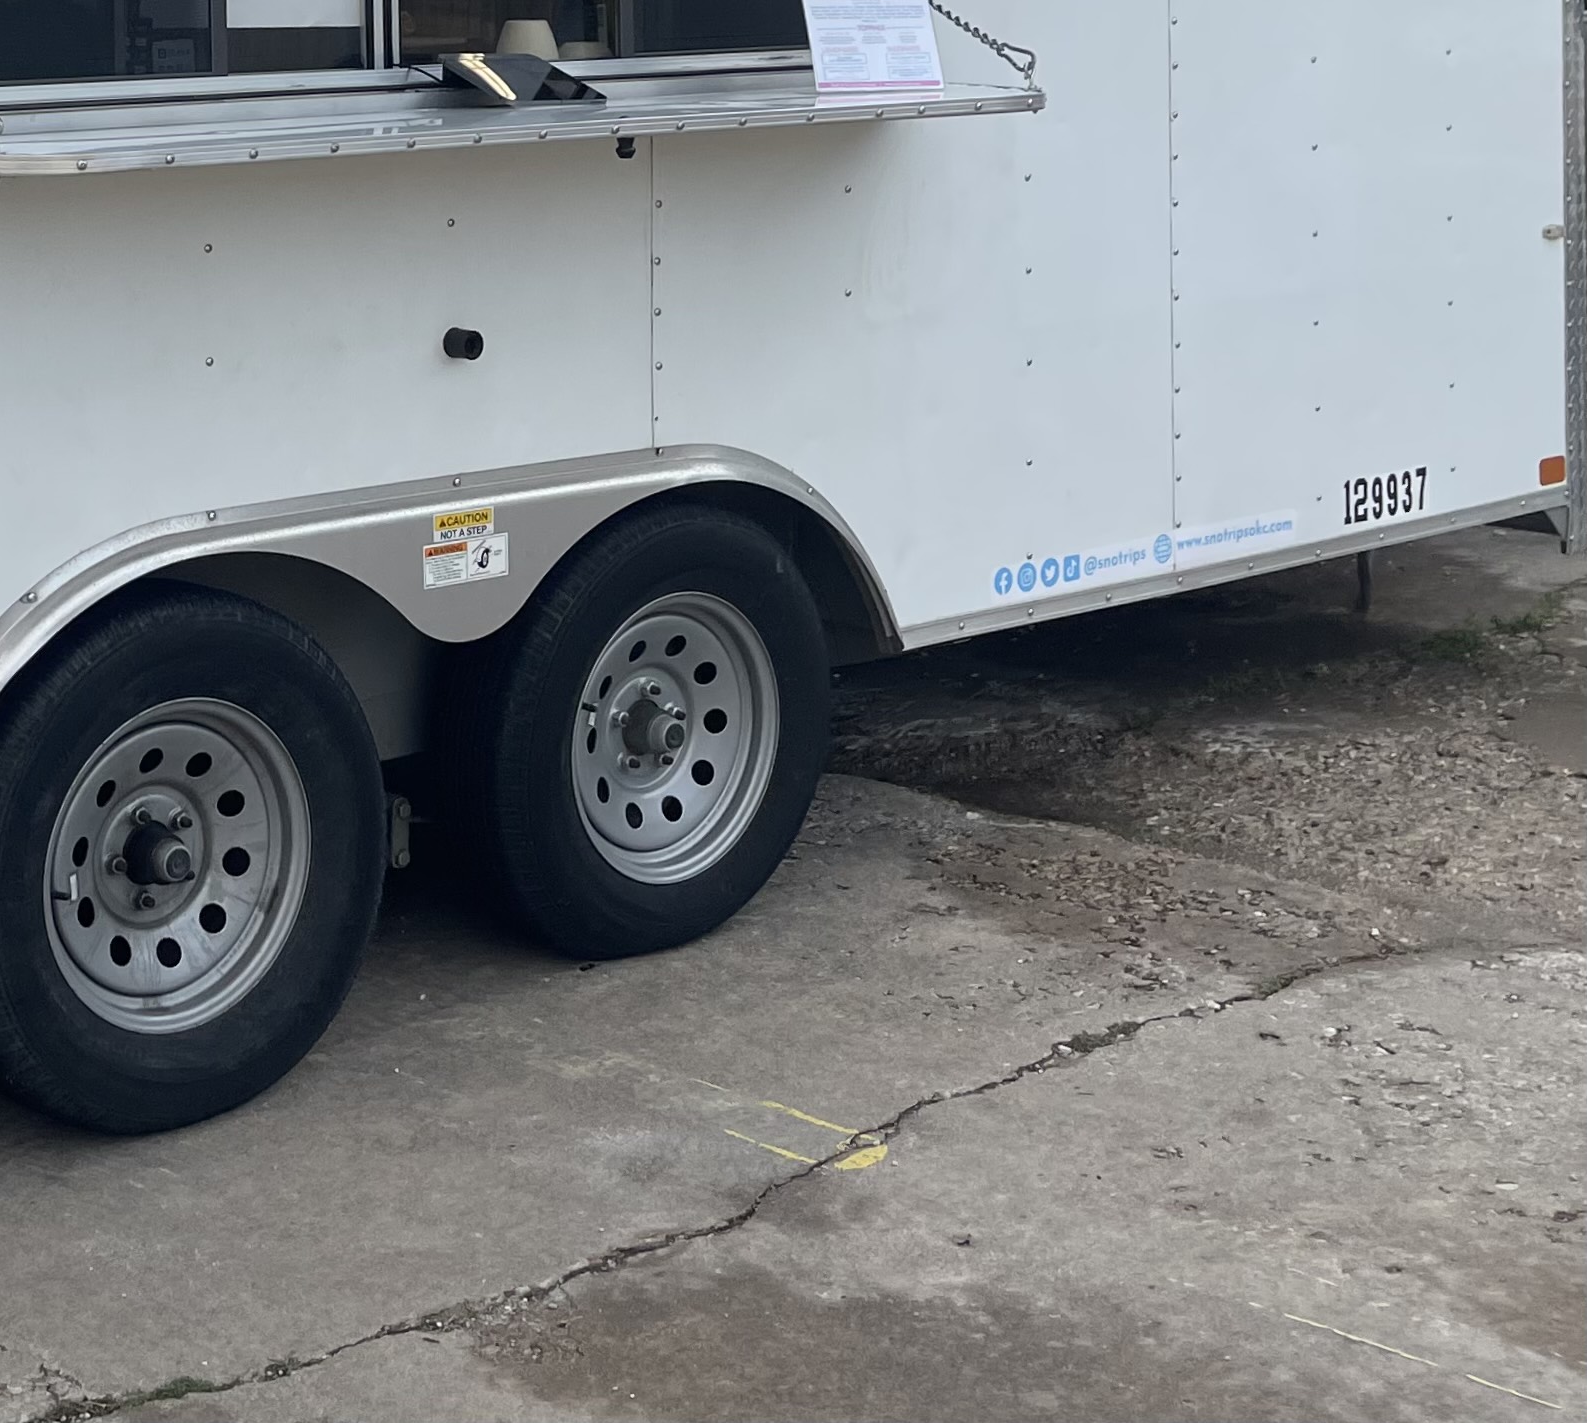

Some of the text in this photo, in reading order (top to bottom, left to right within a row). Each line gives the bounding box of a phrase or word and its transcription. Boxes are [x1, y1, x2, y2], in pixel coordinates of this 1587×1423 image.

[1344, 466, 1427, 525] 129937
[440, 525, 487, 540] NOT A STEP
[446, 511, 488, 526] CAUTION
[1084, 519, 1293, 576] @snotrips www.snotripsokc.com
